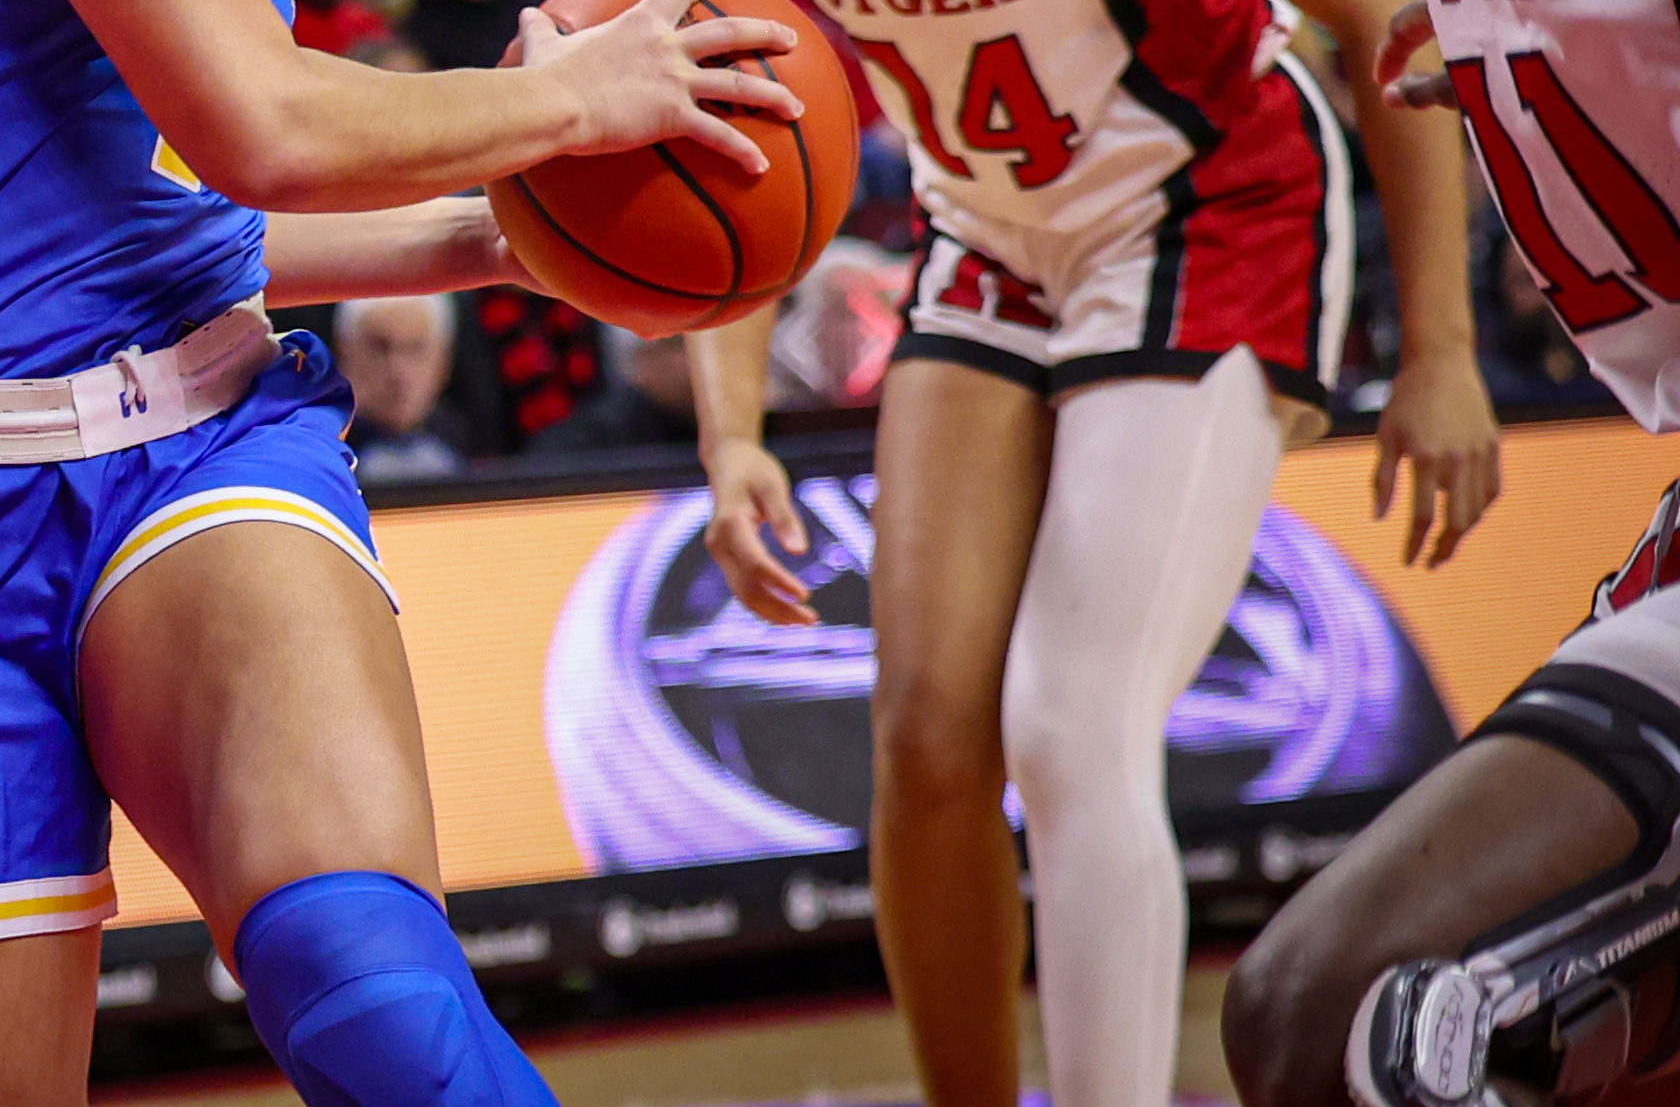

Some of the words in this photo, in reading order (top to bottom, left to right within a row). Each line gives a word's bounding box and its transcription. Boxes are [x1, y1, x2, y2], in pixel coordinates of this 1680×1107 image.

[850, 32, 1081, 191] 14
[1444, 49, 1680, 335] 11
[1597, 907, 1680, 970] TITANIUM
